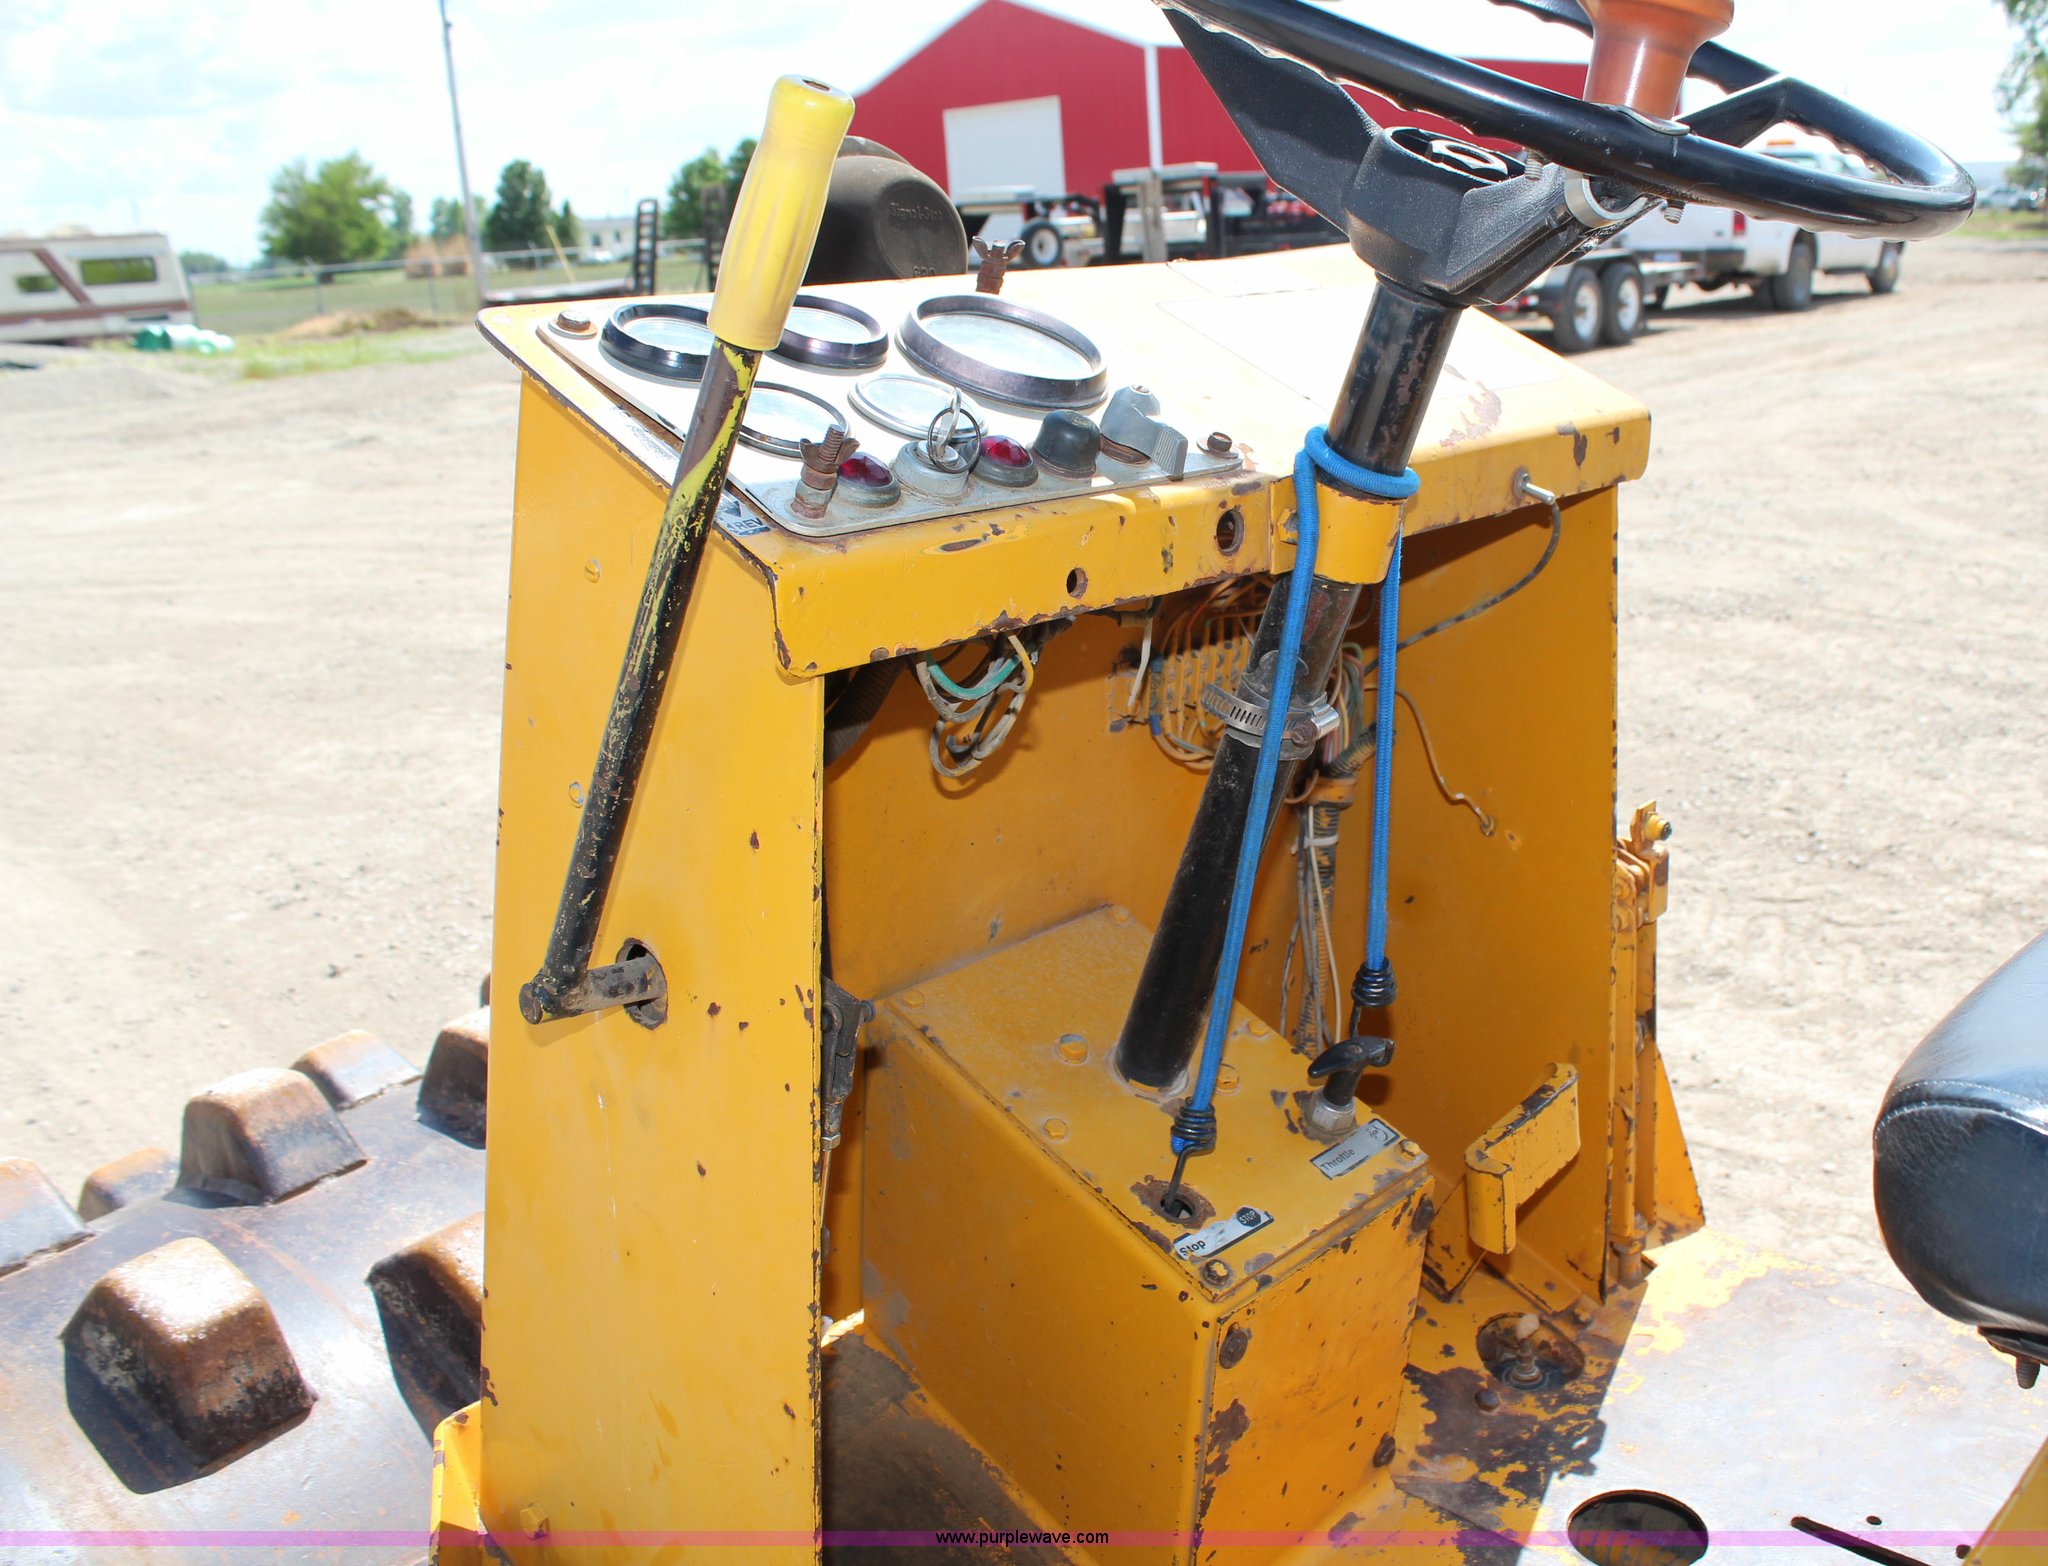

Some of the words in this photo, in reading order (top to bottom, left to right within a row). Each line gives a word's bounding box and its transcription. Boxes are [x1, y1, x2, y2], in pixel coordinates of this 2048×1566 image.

[1320, 1149, 1355, 1172] Throttle
[1239, 1209, 1256, 1225] STOP
[1179, 1239, 1206, 1257] Stop
